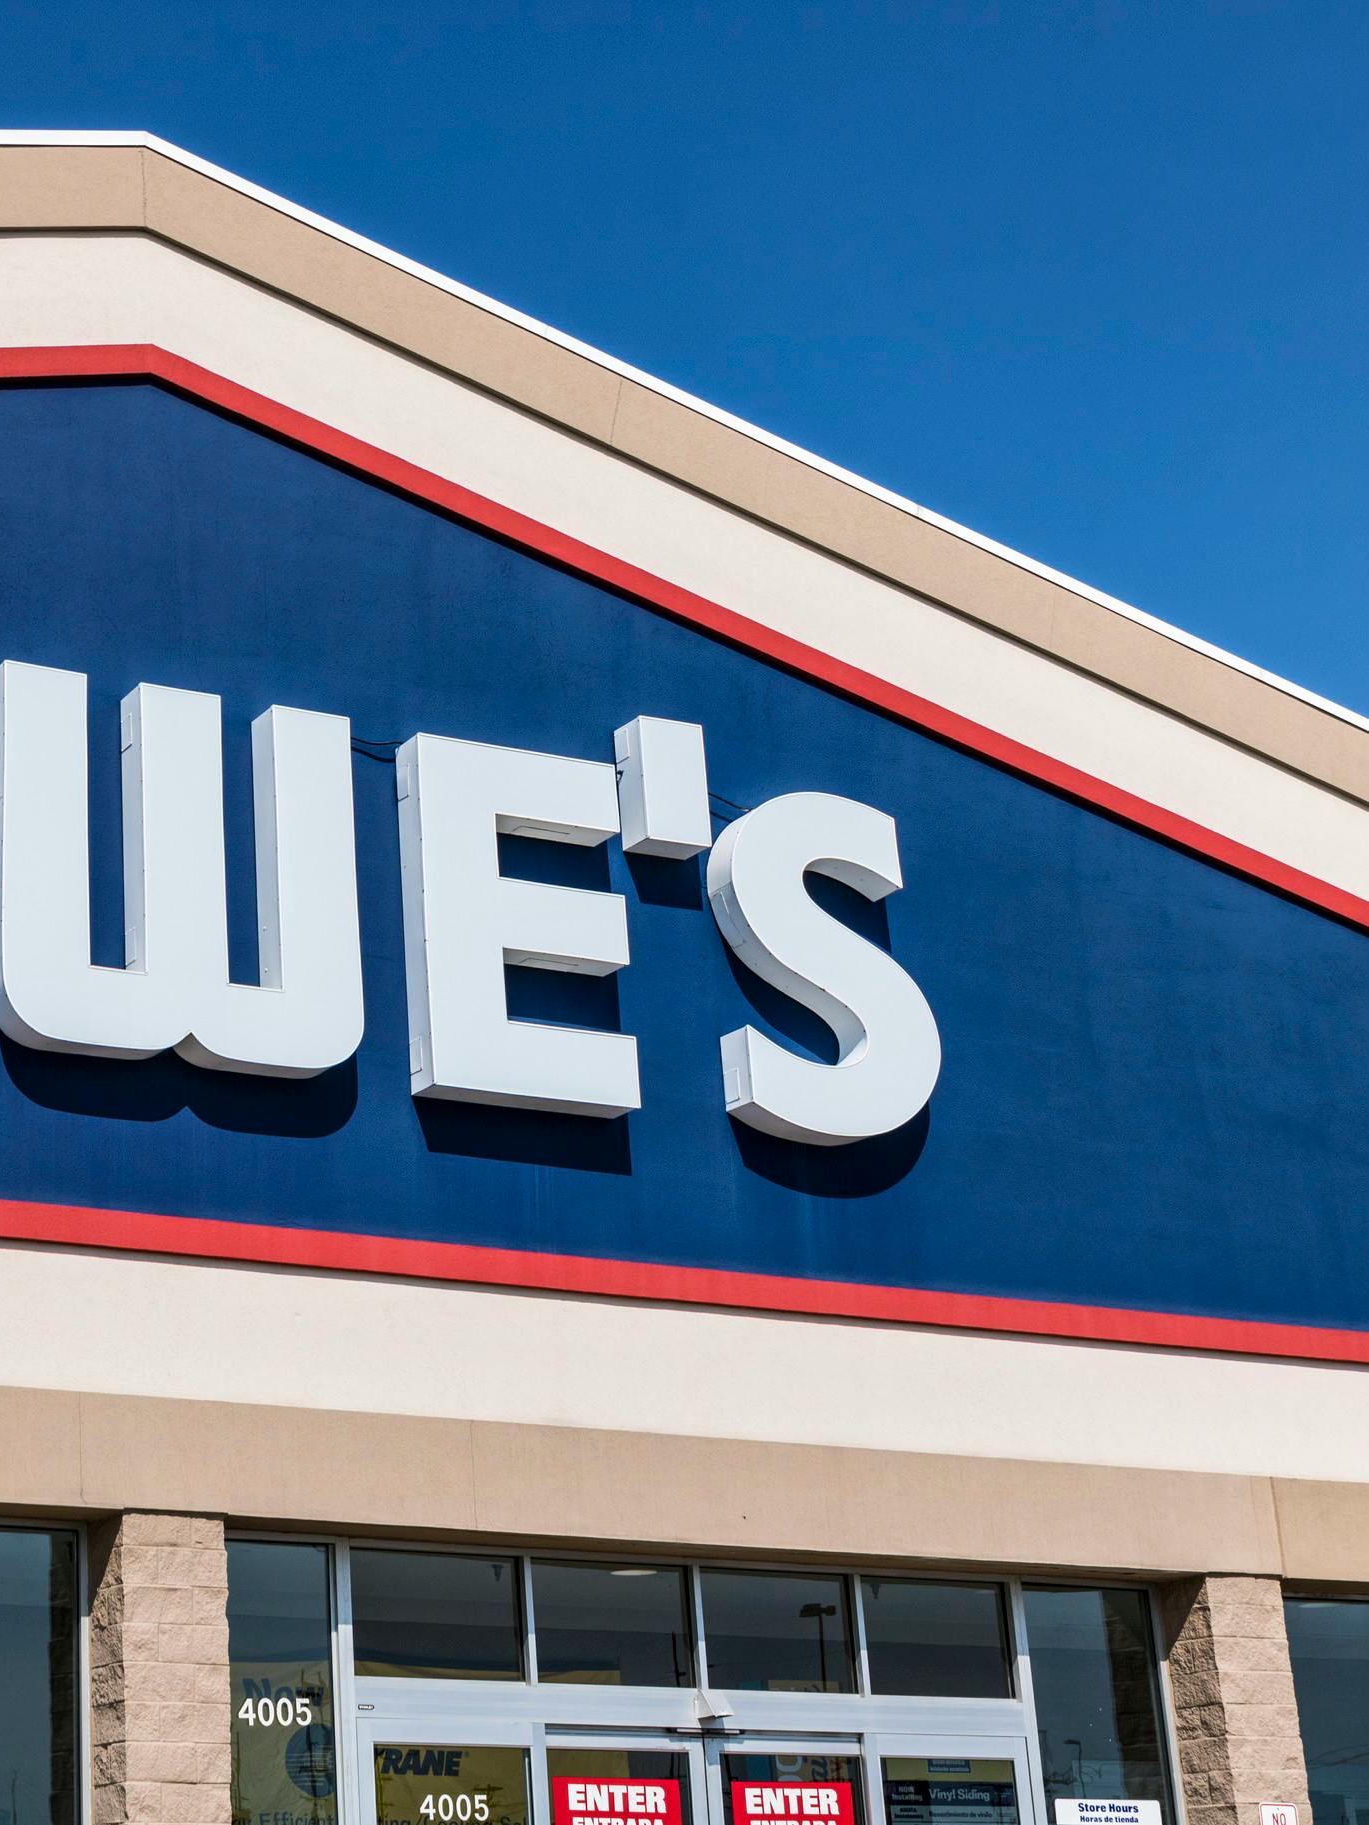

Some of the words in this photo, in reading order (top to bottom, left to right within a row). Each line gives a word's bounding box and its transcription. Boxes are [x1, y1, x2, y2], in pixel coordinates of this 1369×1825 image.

[238, 1697, 312, 1727] 4005
[567, 1782, 667, 1814] ENTER
[744, 1787, 840, 1815] ENTER
[929, 1788, 956, 1801] Vinyl
[957, 1788, 990, 1802] Siding
[419, 1793, 490, 1822] 4005
[1078, 1802, 1107, 1812] Store
[1108, 1803, 1139, 1814] Hours
[1080, 1815, 1103, 1823] Horas
[1104, 1815, 1114, 1823] de
[1115, 1816, 1139, 1824] tienda
[1272, 1813, 1286, 1825] NO
